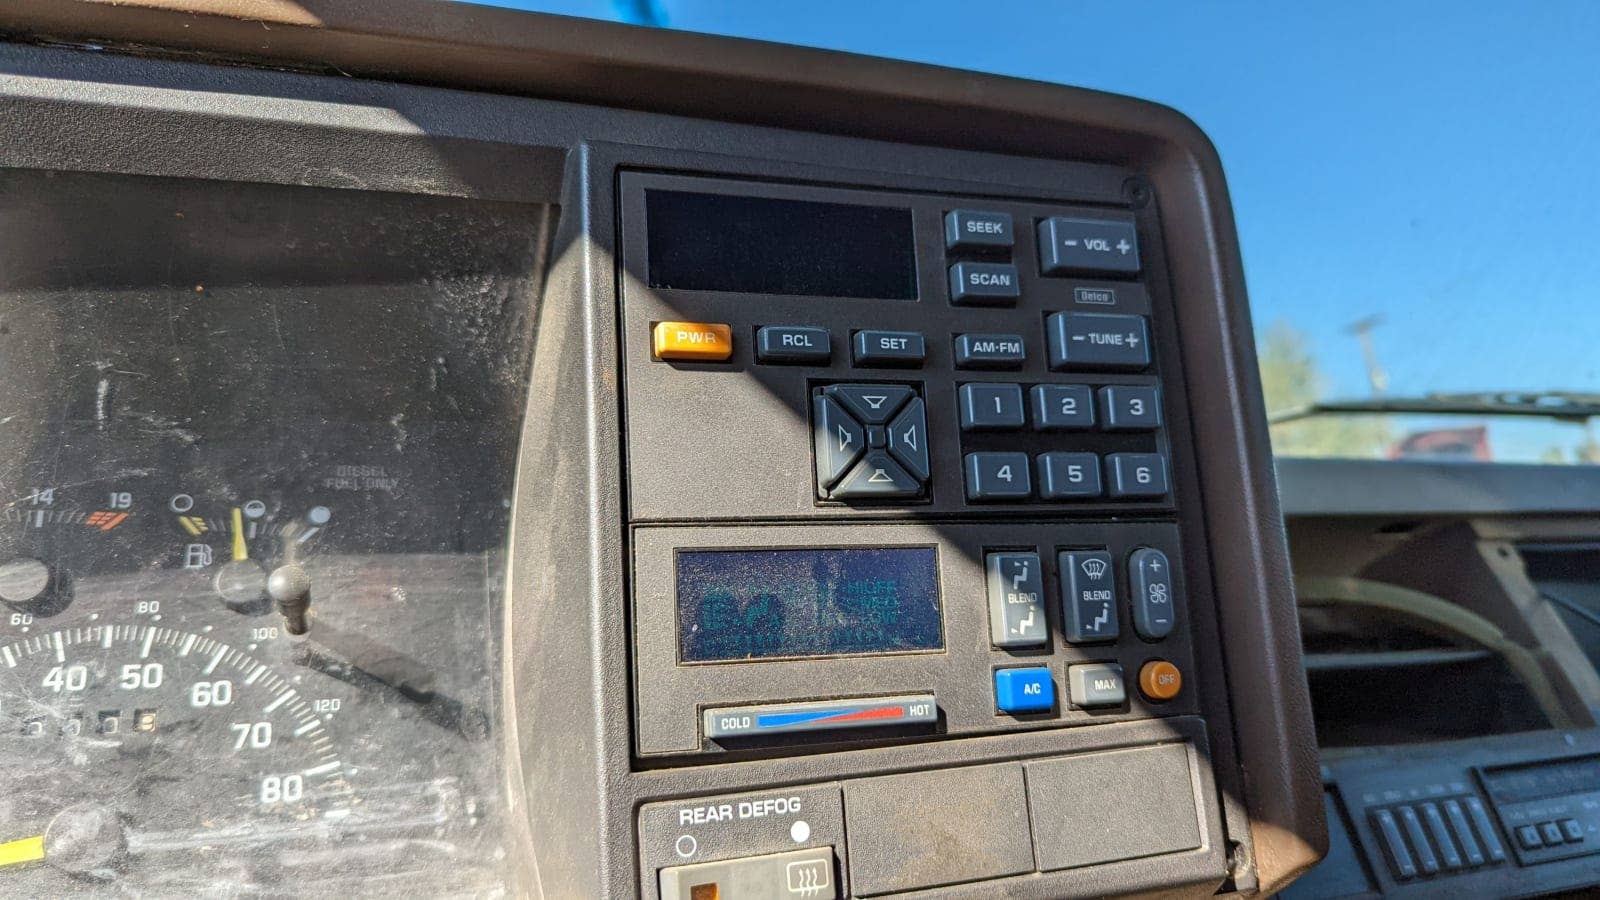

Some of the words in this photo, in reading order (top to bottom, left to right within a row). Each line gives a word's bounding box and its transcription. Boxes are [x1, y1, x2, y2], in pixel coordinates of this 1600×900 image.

[966, 219, 1003, 235] SEEK
[1084, 238, 1111, 252] VOL
[969, 272, 1011, 287] SCAN
[676, 331, 716, 345] PWR
[782, 333, 813, 348] RCL
[880, 337, 908, 351] SET
[1088, 333, 1122, 346] TUNE
[993, 397, 1002, 414] 1
[1061, 397, 1076, 415] 2
[1129, 398, 1144, 415] 3
[336, 464, 388, 477] DIESEL
[996, 465, 1013, 482] 4
[1068, 466, 1083, 482] 5
[1136, 466, 1151, 483] 6
[32, 488, 54, 505] 14
[109, 492, 132, 509] 19
[1008, 591, 1038, 603] BLEND
[1083, 588, 1112, 601] BLEND
[137, 600, 160, 614] 80
[10, 613, 33, 627] 60
[252, 627, 278, 640] 100
[42, 665, 87, 693] 40
[120, 663, 164, 691] 50
[1157, 673, 1176, 687] OFF
[1023, 682, 1041, 696] A/C
[1094, 679, 1117, 692] MAX
[191, 680, 232, 707] 60
[314, 698, 341, 712] 120
[908, 702, 930, 717] HOT
[720, 716, 751, 730] COLD
[231, 721, 273, 749] 70
[260, 775, 304, 803] 80
[678, 802, 733, 826] REAR
[737, 795, 802, 819] DEFOG
